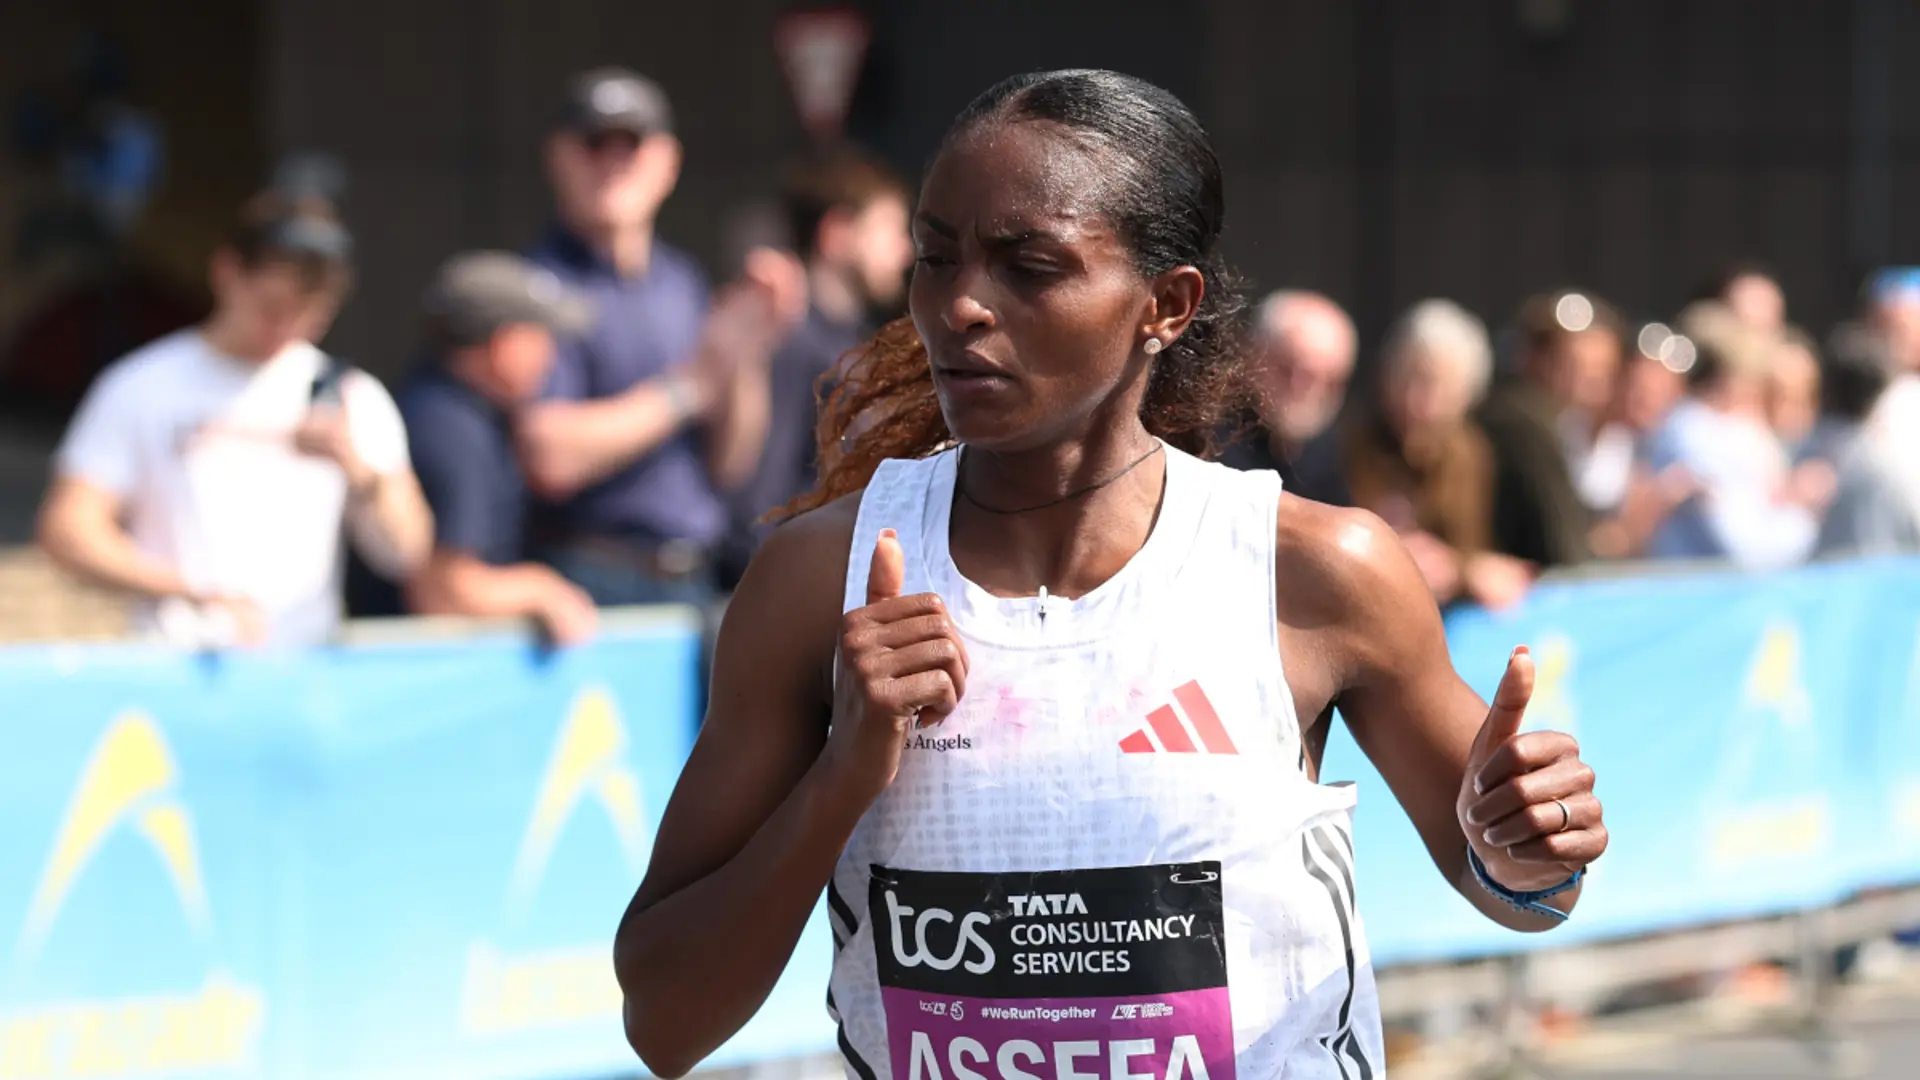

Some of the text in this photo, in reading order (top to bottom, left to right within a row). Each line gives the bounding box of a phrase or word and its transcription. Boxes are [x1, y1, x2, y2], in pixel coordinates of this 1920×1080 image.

[913, 733, 972, 752] Angels
[1007, 894, 1089, 916] TATA
[884, 890, 996, 974] tcs
[1010, 914, 1196, 946] CONSULTANCY
[1012, 950, 1131, 974] SERVICES
[981, 1006, 1097, 1022] #WeRunTogether
